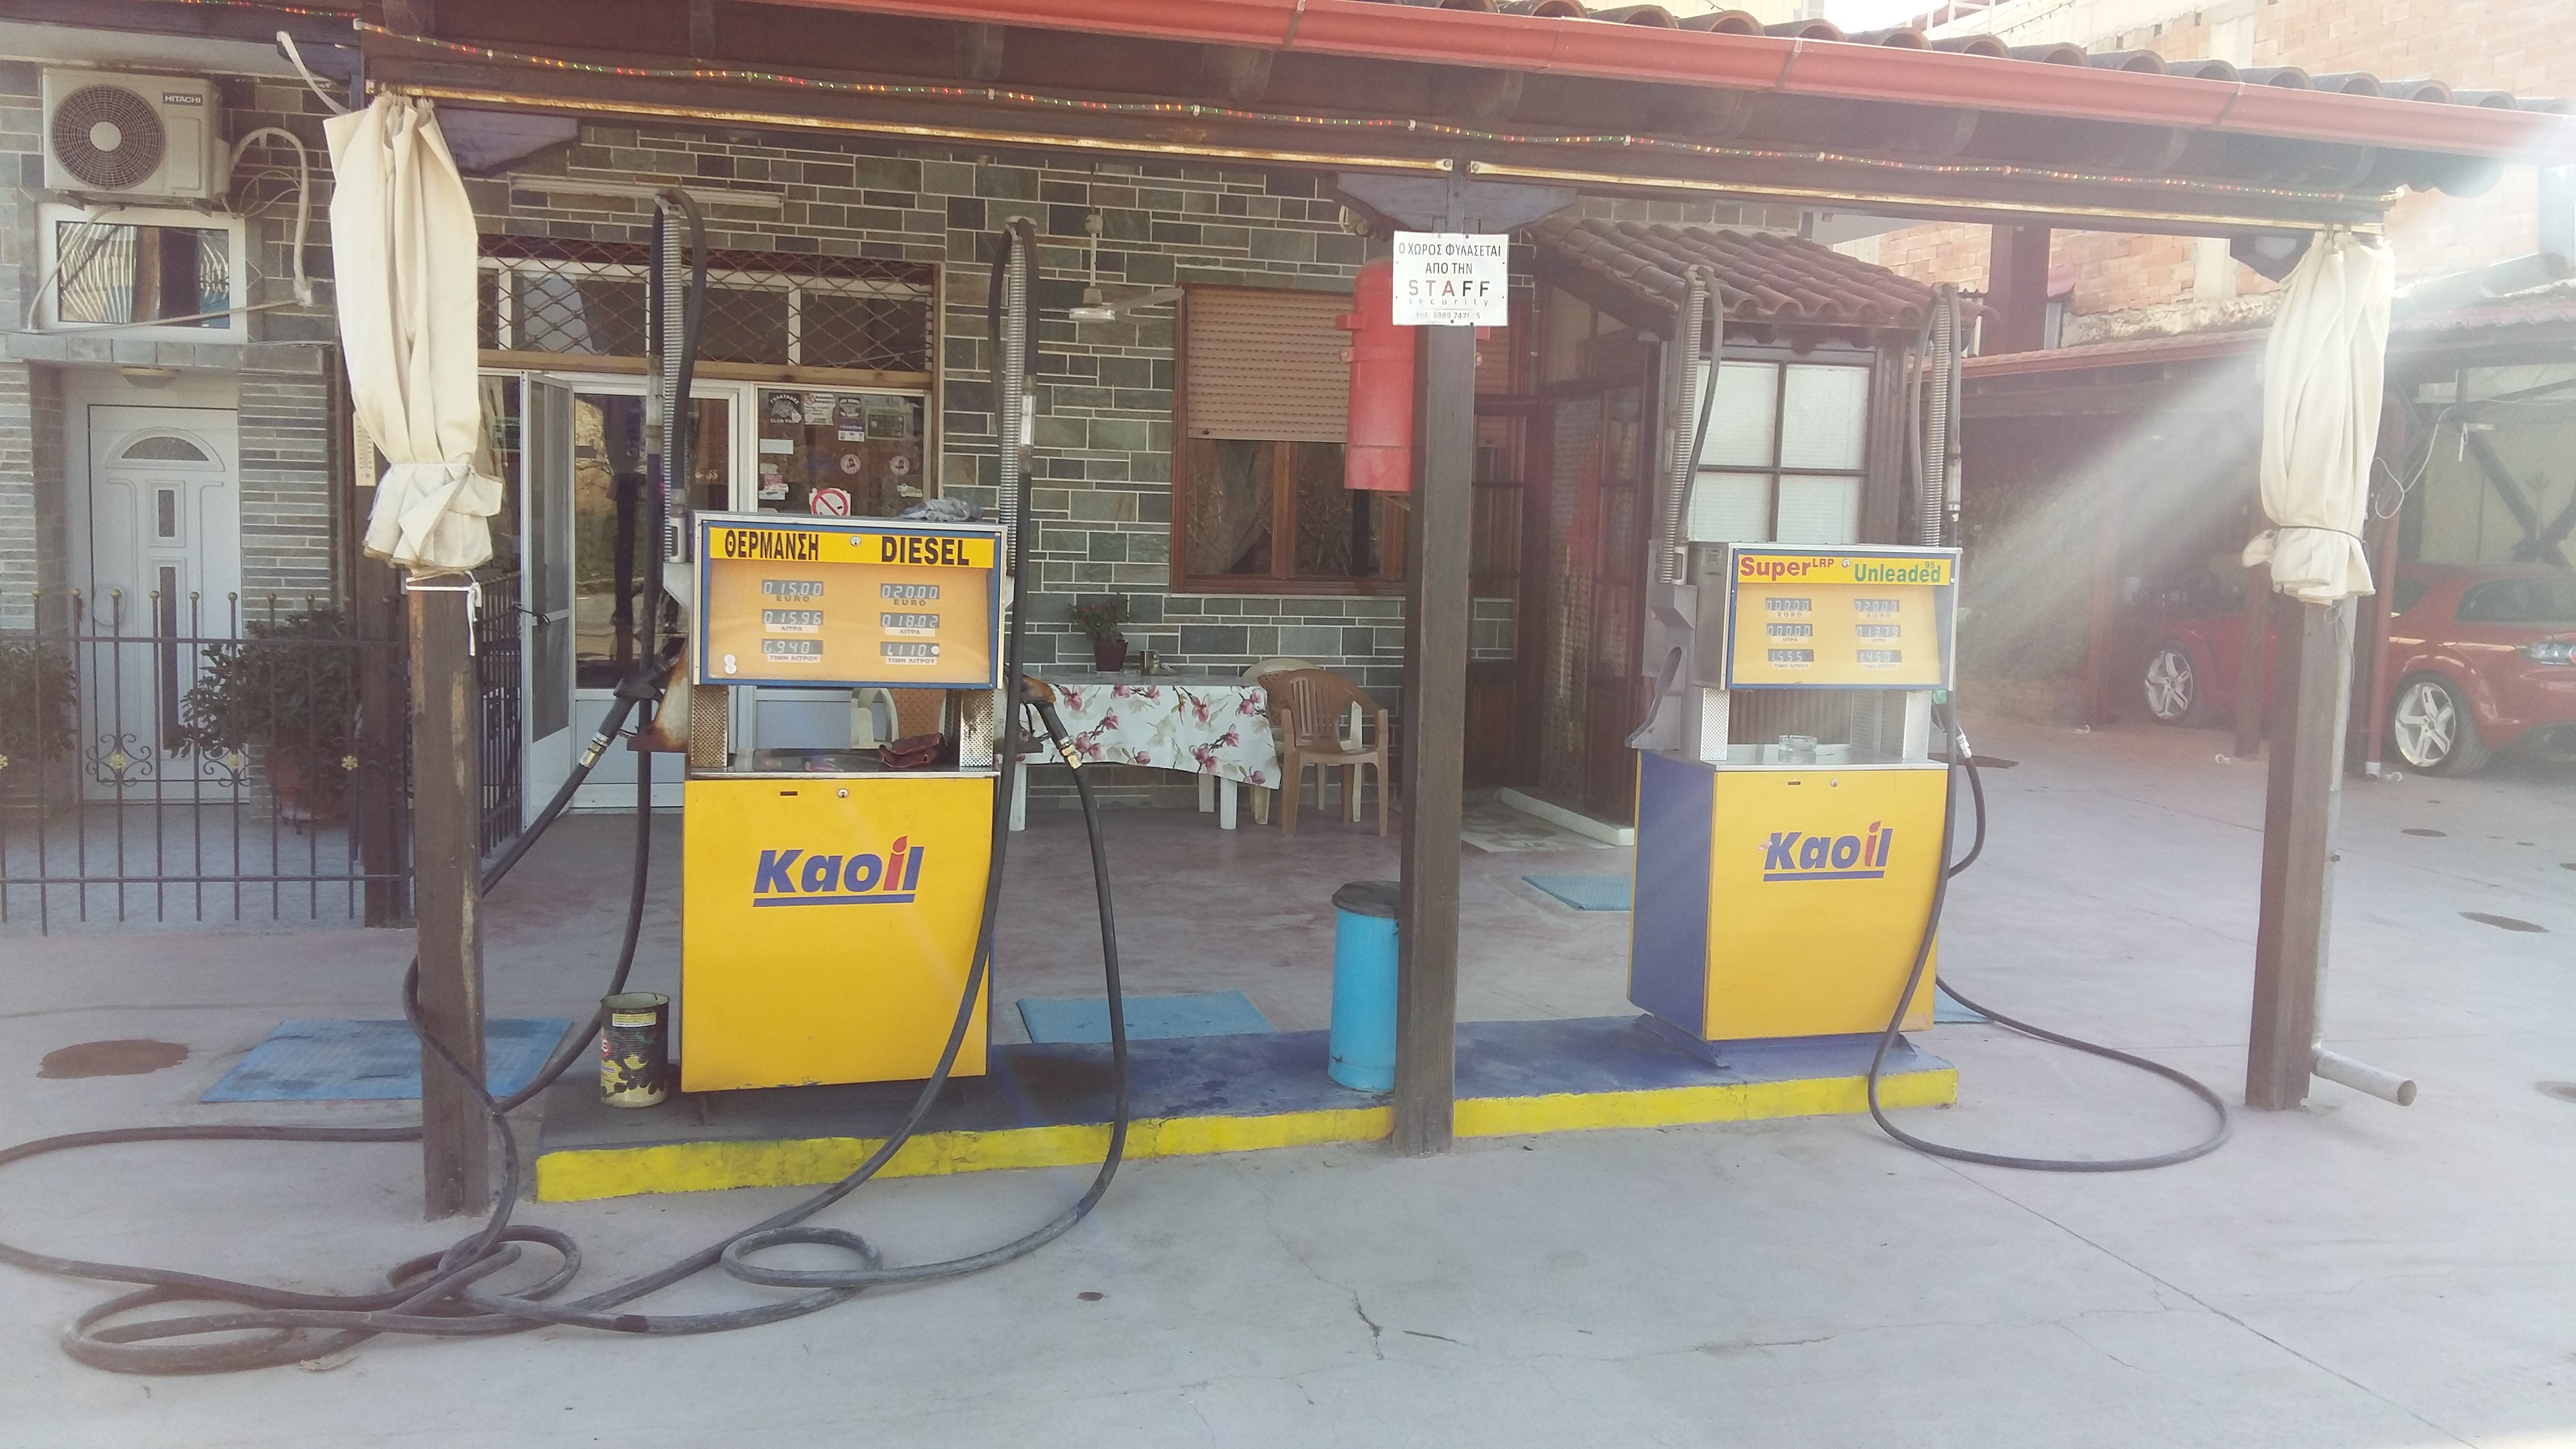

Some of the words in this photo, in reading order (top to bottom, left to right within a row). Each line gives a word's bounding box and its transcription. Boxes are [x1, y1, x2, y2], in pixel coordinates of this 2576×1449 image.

[165, 95, 201, 104] HITACHI
[1408, 243, 1442, 255] ΧΩΡΟΣ
[1445, 243, 1501, 256] ΦΥΛΑΣΕΤΑΙ
[1425, 262, 1448, 274] ΑΠΟ
[1451, 263, 1473, 275] ΤΗΝ
[1408, 280, 1490, 297] STAFF
[1408, 298, 1488, 306] security
[724, 530, 819, 560] ΘΕΡΜΑΝΣΗ
[882, 536, 969, 565] DIESEL
[1740, 557, 1810, 581] Super
[1812, 558, 1834, 568] LRP
[1855, 564, 1941, 582] Unleaded
[1925, 561, 1935, 569] 95
[1764, 821, 1893, 870] Kaoil
[753, 836, 925, 893] Kaoil
